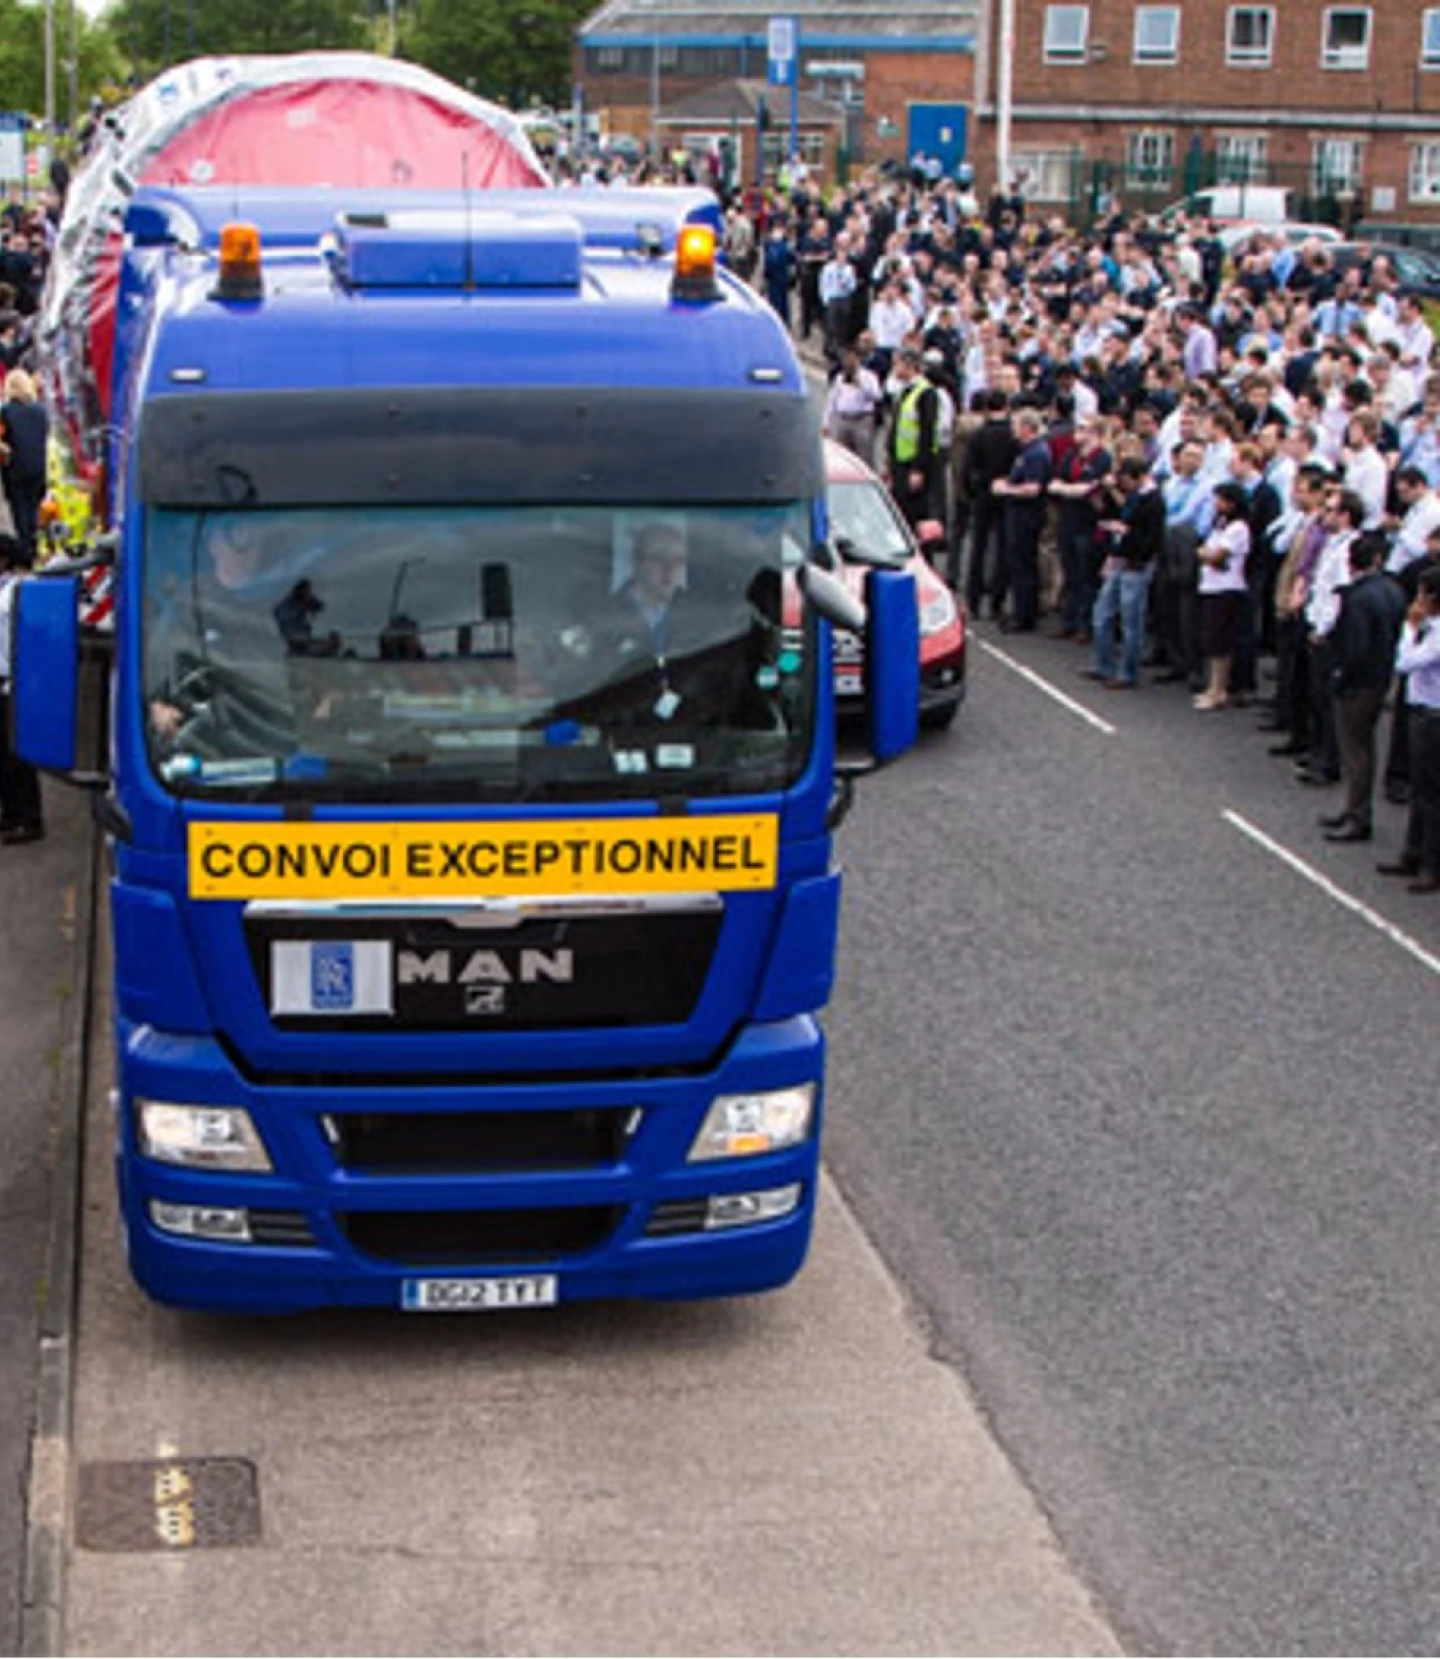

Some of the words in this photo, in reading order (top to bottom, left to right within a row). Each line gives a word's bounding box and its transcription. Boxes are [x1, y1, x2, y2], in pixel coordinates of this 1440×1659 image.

[201, 842, 390, 878] CONVOI
[406, 835, 765, 877] EXCEPTIONNEL
[397, 948, 573, 984] MAN
